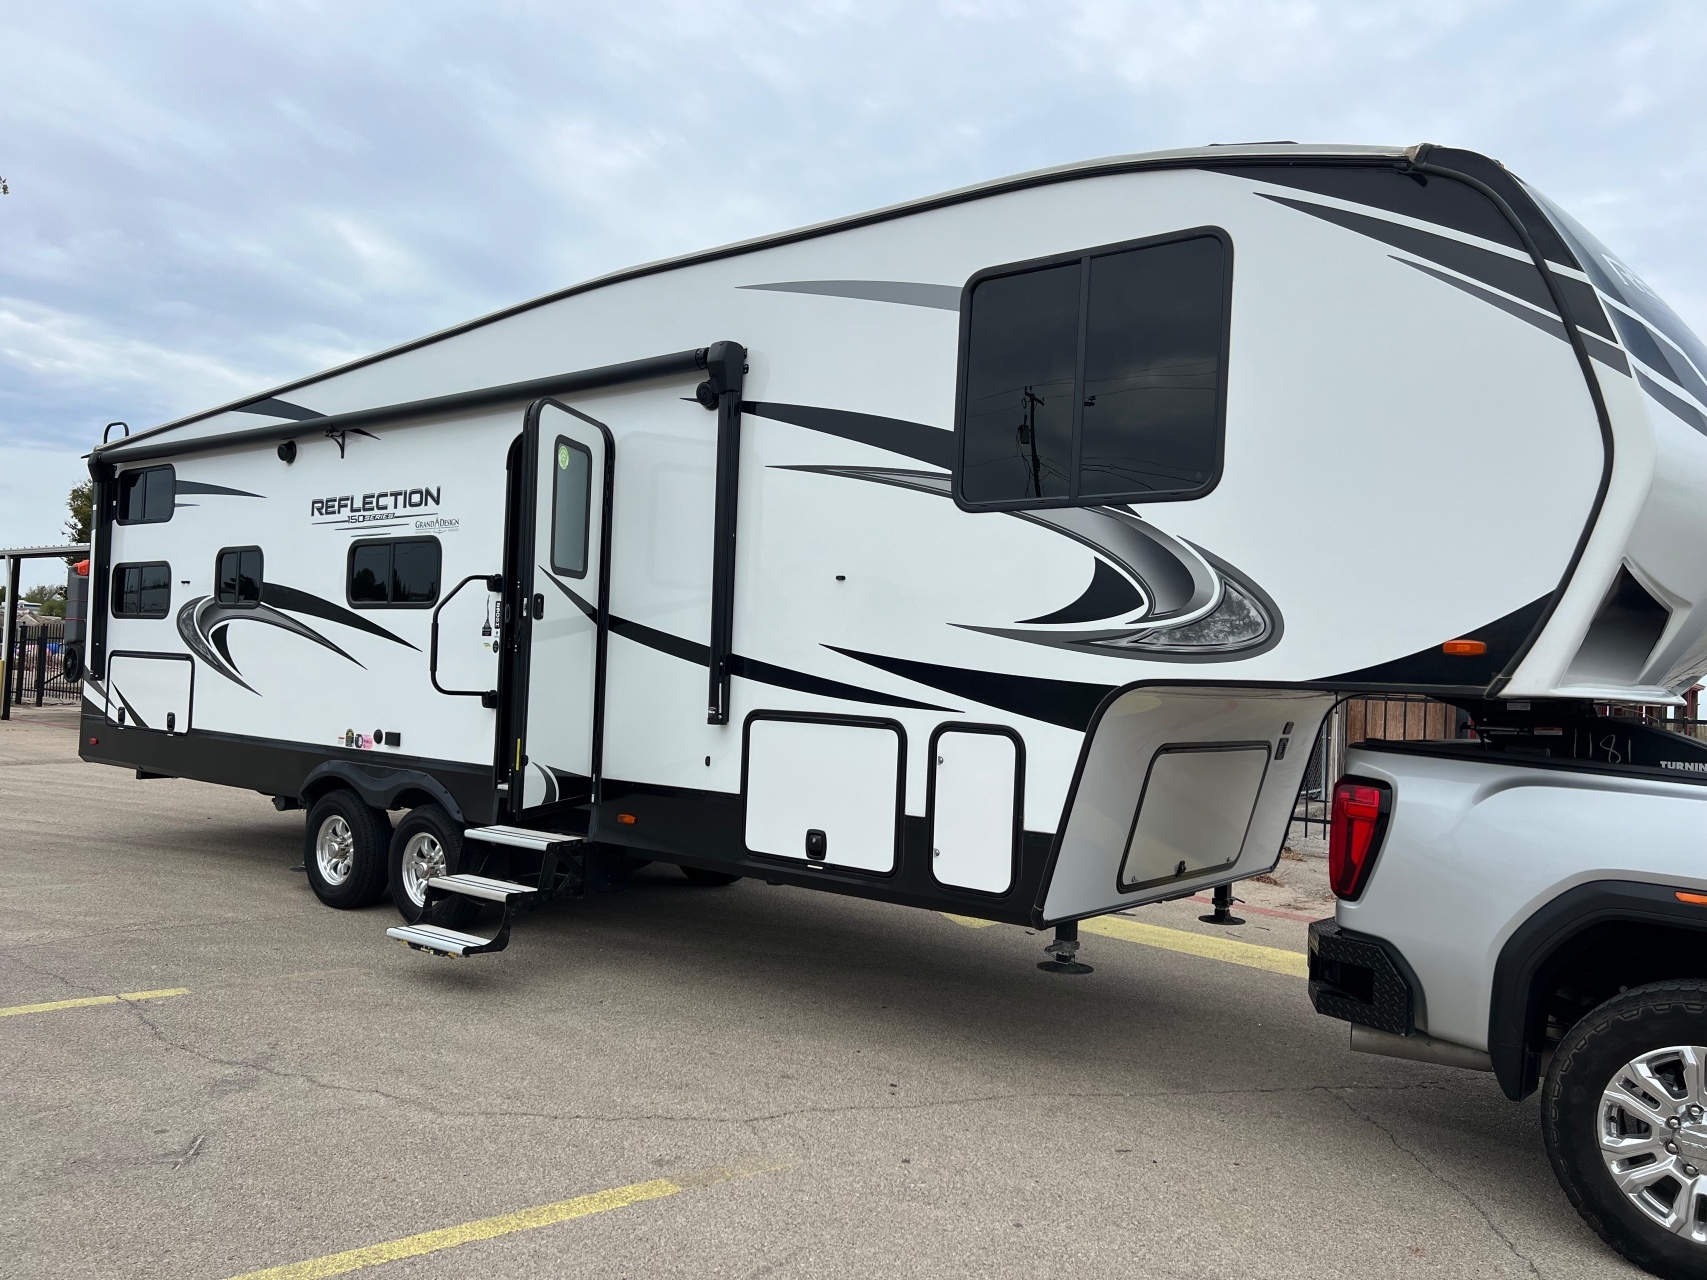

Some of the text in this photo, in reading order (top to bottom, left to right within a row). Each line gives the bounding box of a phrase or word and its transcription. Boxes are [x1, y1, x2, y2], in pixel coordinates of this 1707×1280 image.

[311, 486, 441, 516] REFLECTION
[415, 518, 460, 528] GRAND DESIGN
